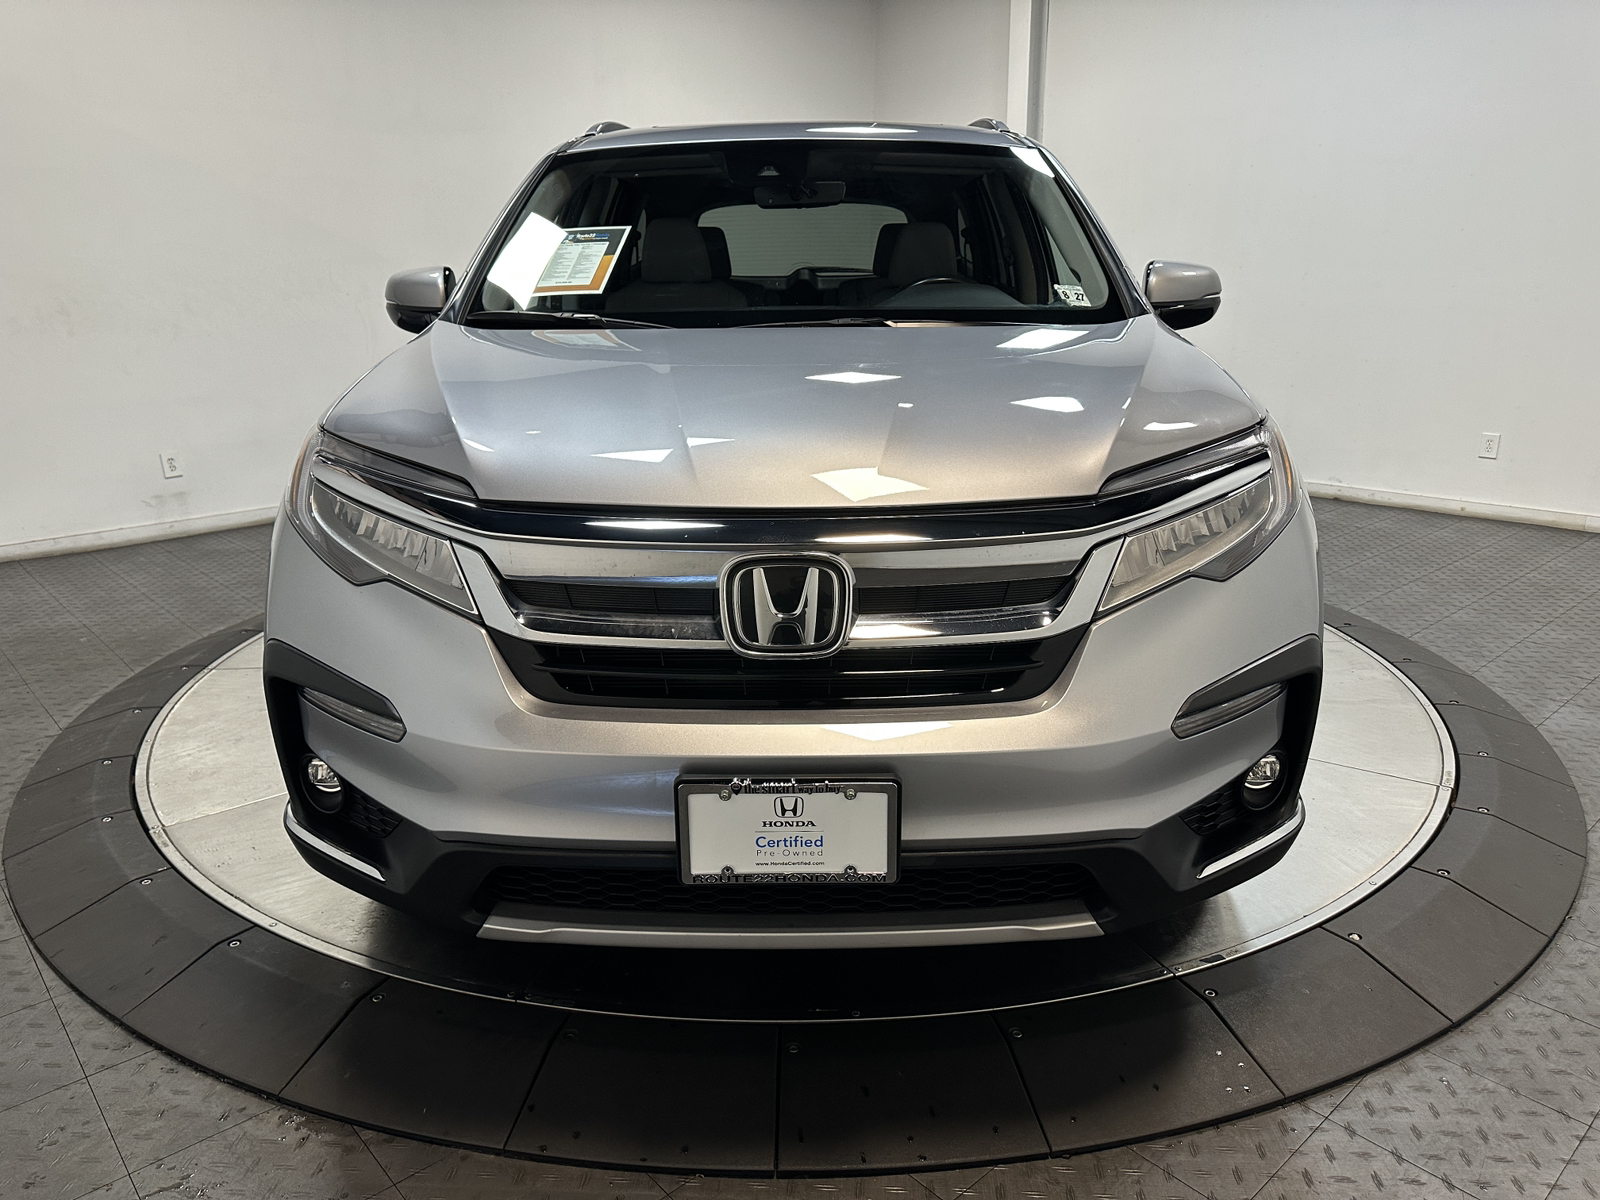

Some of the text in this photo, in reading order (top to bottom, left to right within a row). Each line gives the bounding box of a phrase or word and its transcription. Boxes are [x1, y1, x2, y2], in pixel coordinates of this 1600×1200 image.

[1062, 291, 1084, 301] 8 27
[744, 782, 760, 794] the
[798, 786, 814, 795] way
[815, 784, 824, 794] to
[825, 782, 841, 795] buy
[761, 820, 817, 828] HONDA
[755, 835, 824, 848] Certified
[756, 849, 823, 857] Pre-Owned
[692, 873, 887, 884] ROUTE22HONDA.COM
